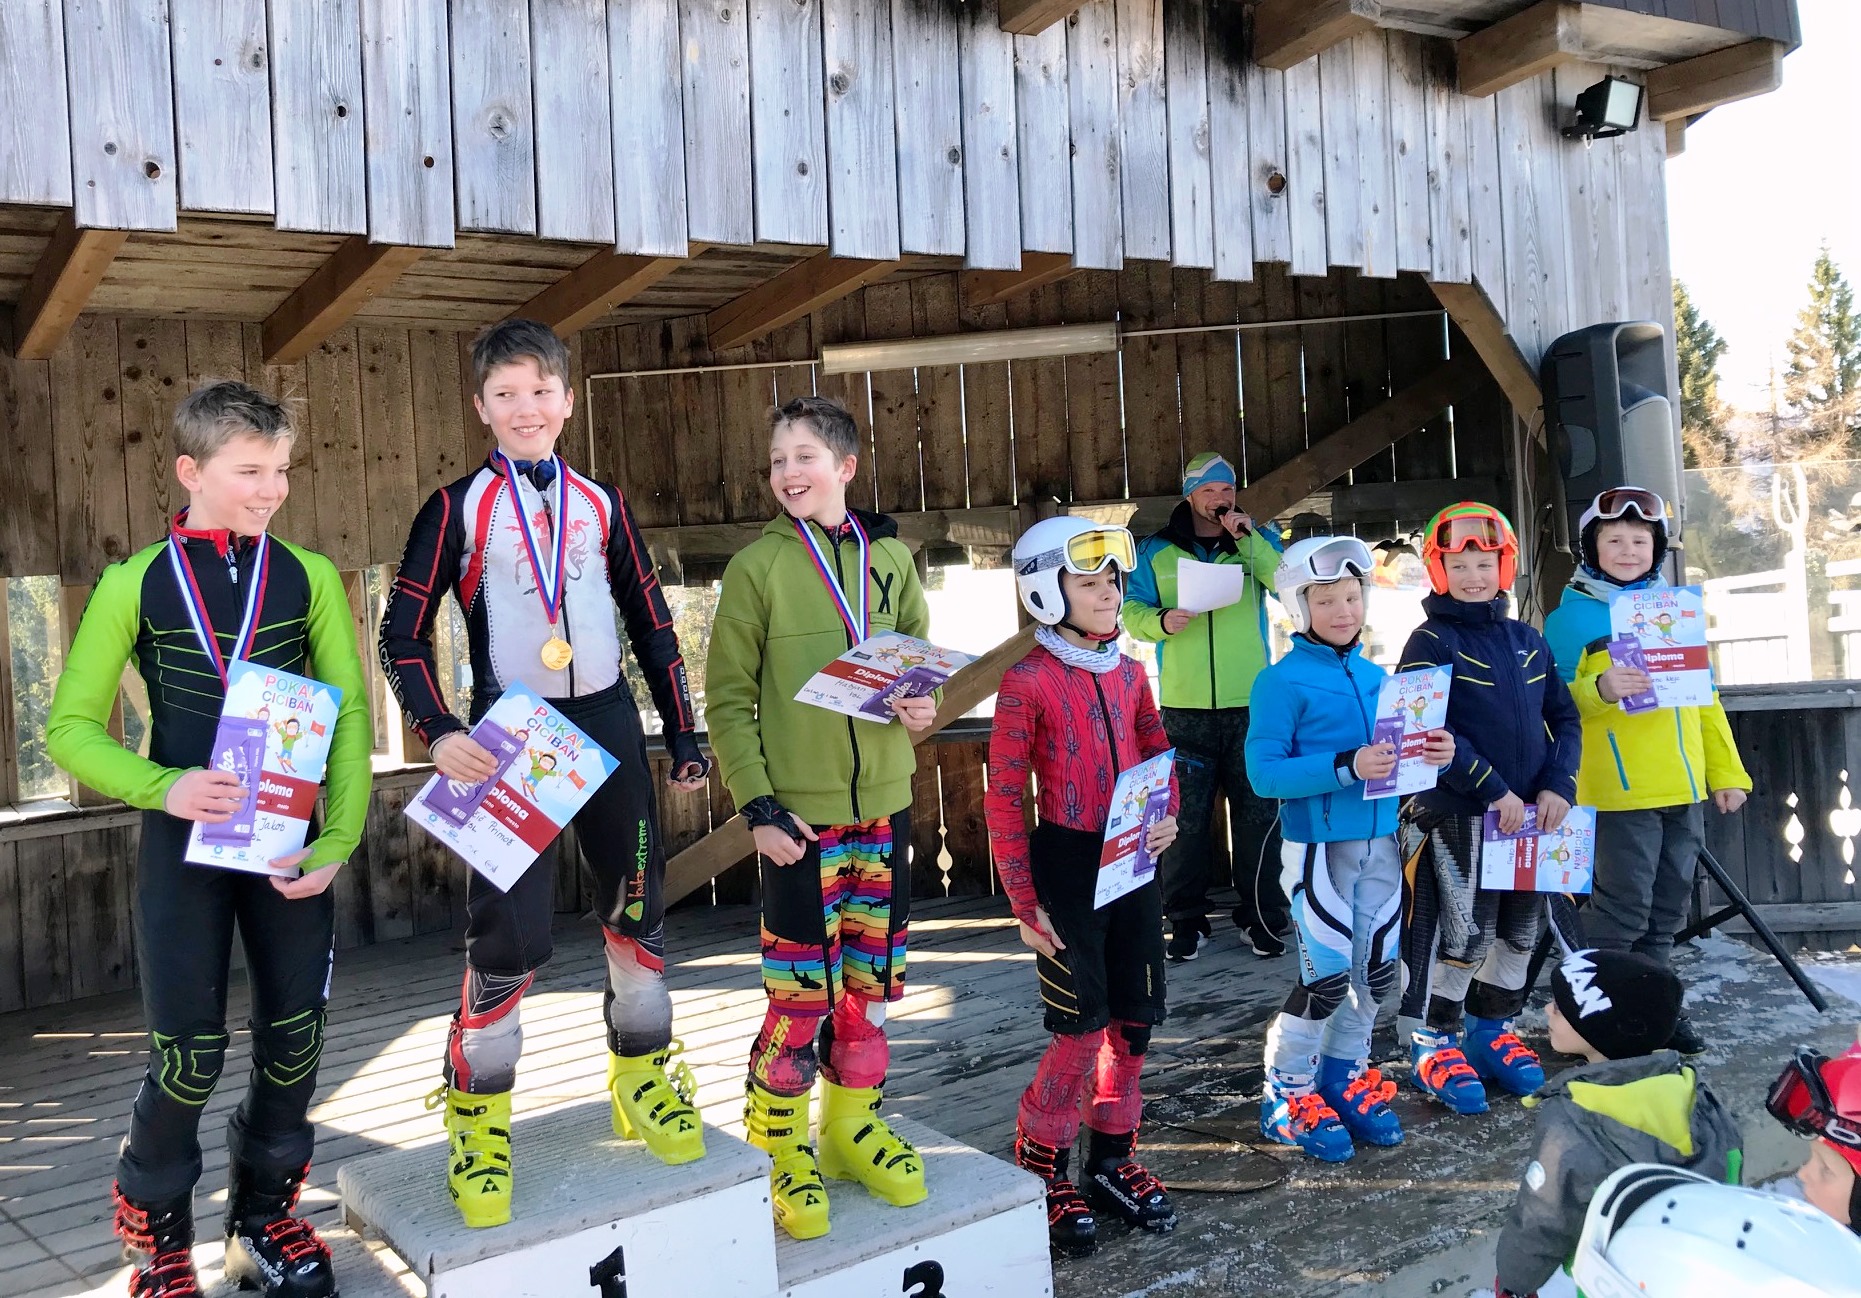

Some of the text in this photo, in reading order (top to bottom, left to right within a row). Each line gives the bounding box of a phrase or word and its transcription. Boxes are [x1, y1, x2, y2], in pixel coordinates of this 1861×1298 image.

[1632, 591, 1676, 602] POKAL
[1633, 600, 1679, 611] CICIBAN
[264, 673, 316, 702] POKAL
[853, 667, 895, 685] Diplom
[1399, 681, 1434, 696] CICIBAN
[262, 690, 314, 714] CICIBAN
[526, 717, 580, 763] CICIBAN
[534, 705, 586, 753] POKAL
[1401, 737, 1427, 750] ploma
[258, 778, 294, 799] ploma
[488, 785, 531, 821] ploma
[1118, 831, 1142, 849] Diplom
[1525, 836, 1535, 869] ploma
[1573, 828, 1584, 870] CICIBAN
[238, 1235, 285, 1287] NORDICA
[589, 1245, 628, 1298] 1
